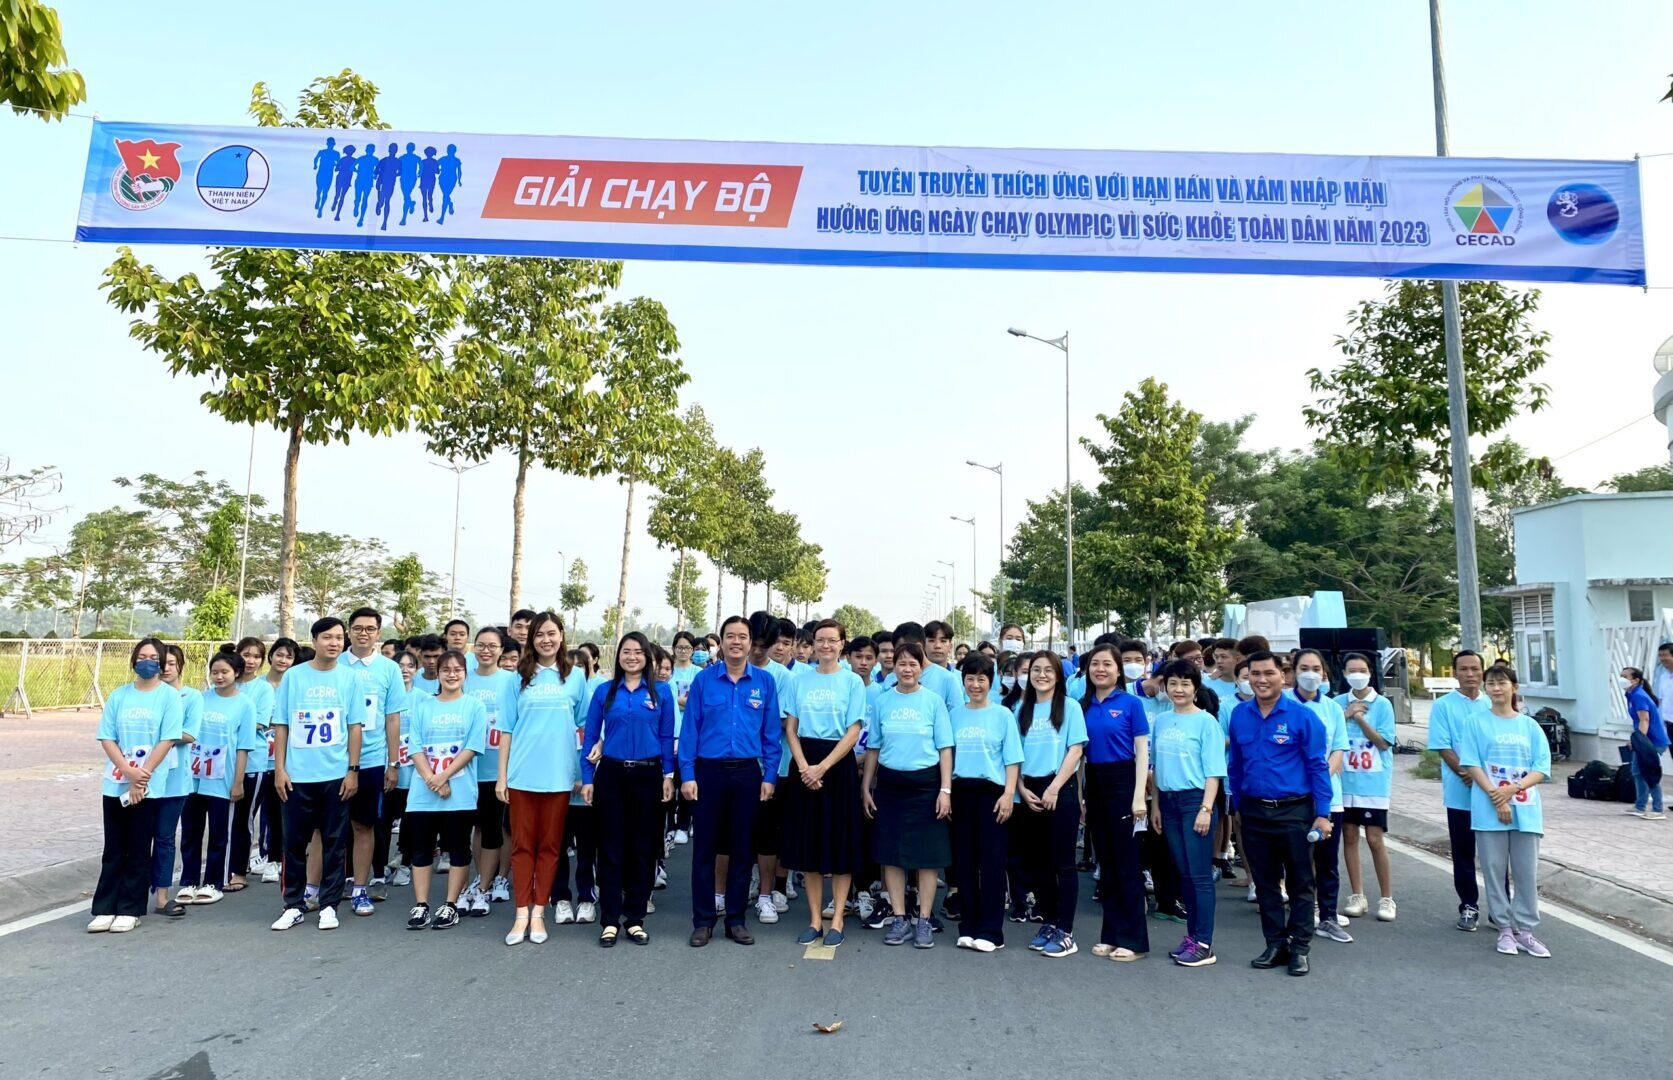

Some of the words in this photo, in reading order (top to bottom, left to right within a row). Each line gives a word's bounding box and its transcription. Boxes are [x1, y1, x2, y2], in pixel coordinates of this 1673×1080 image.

[236, 190, 255, 198] NIÊN
[513, 164, 593, 208] GIẢI
[599, 178, 709, 219] CHẠY
[714, 172, 773, 222] BỘ
[857, 167, 915, 195] TUYÊN
[918, 165, 988, 197] TRUYỀN
[992, 170, 1049, 198] THÍCH
[1052, 169, 1091, 199] ỨNG
[1095, 171, 1128, 200] VỚI
[1132, 176, 1171, 206] HẠN
[1216, 175, 1243, 203] VÀ
[1246, 175, 1287, 204] XÂM
[1290, 177, 1340, 210] NHẬP
[1344, 178, 1387, 210] MẶN
[817, 202, 880, 234] HƯỞNG
[885, 206, 924, 235] ỨNG
[928, 206, 977, 235] NGÀY
[981, 210, 1030, 240] CHẠY
[1035, 212, 1115, 238] OLYMPIC
[1118, 212, 1138, 239] VÌ
[1142, 211, 1181, 240] SỨC
[1185, 210, 1236, 241] KHỎE
[1238, 214, 1288, 242] TOÀN
[1291, 214, 1331, 244] DÂN
[1334, 216, 1377, 245] NĂM
[1379, 220, 1430, 246] 2023
[1455, 234, 1516, 246] CECAD
[305, 685, 338, 699] CCBRC
[890, 707, 921, 721] CCBRC
[303, 723, 332, 745] 79
[191, 757, 212, 776] 41
[1348, 751, 1372, 770] 48
